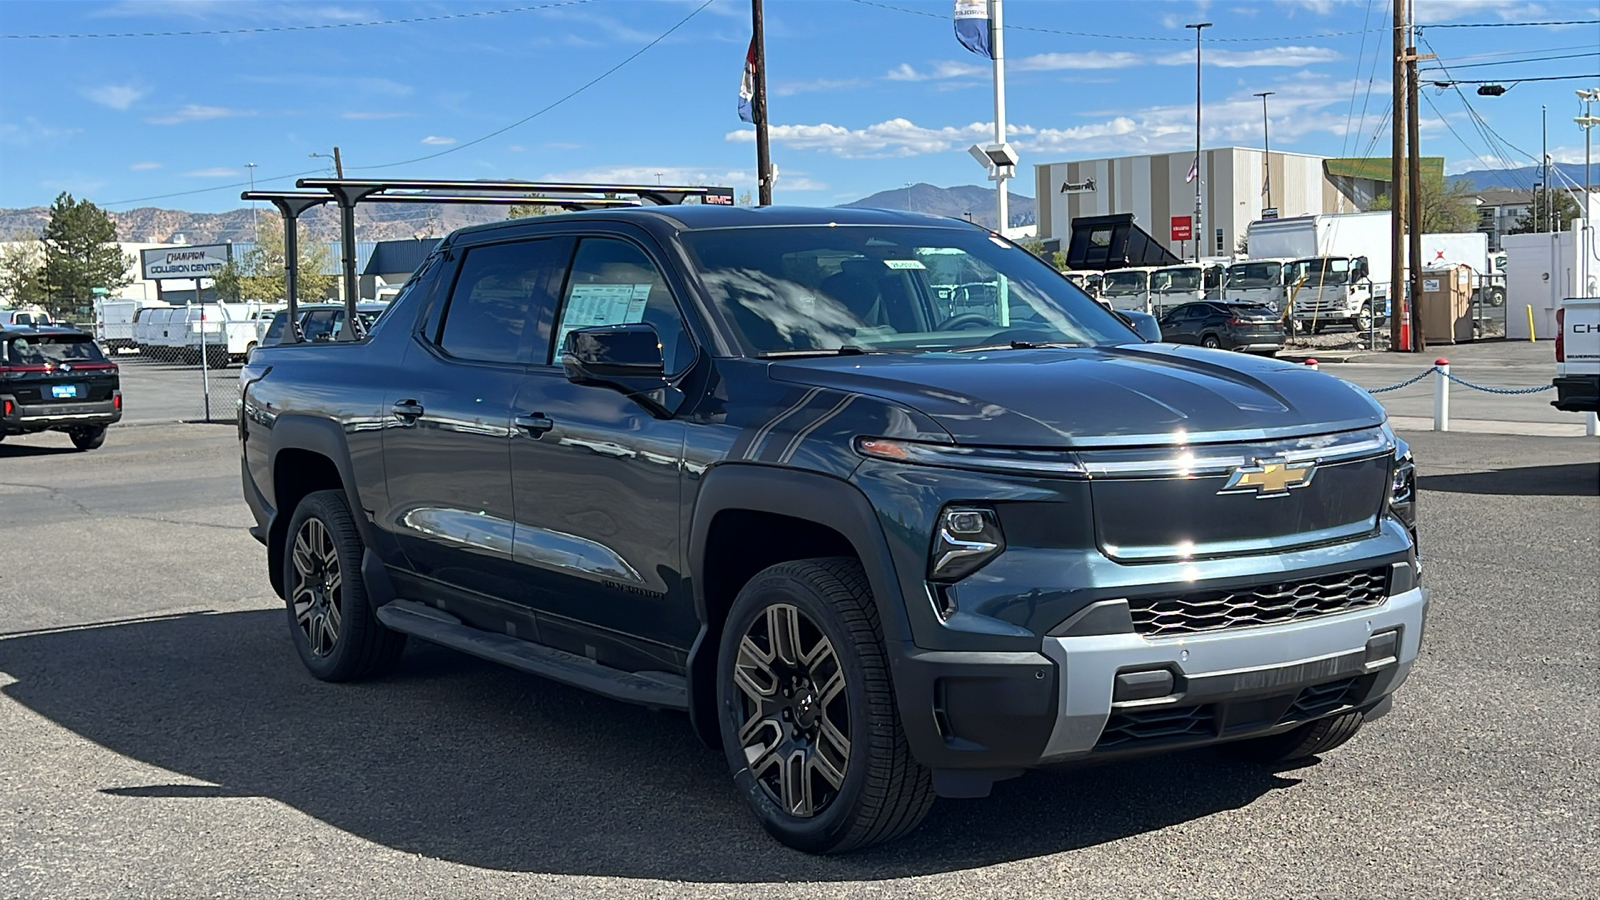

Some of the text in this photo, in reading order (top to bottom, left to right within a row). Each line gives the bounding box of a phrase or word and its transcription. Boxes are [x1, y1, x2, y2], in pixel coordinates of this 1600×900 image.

[705, 194, 732, 205] GMC
[166, 251, 205, 264] CHAMPION
[151, 264, 189, 274] COLLISION
